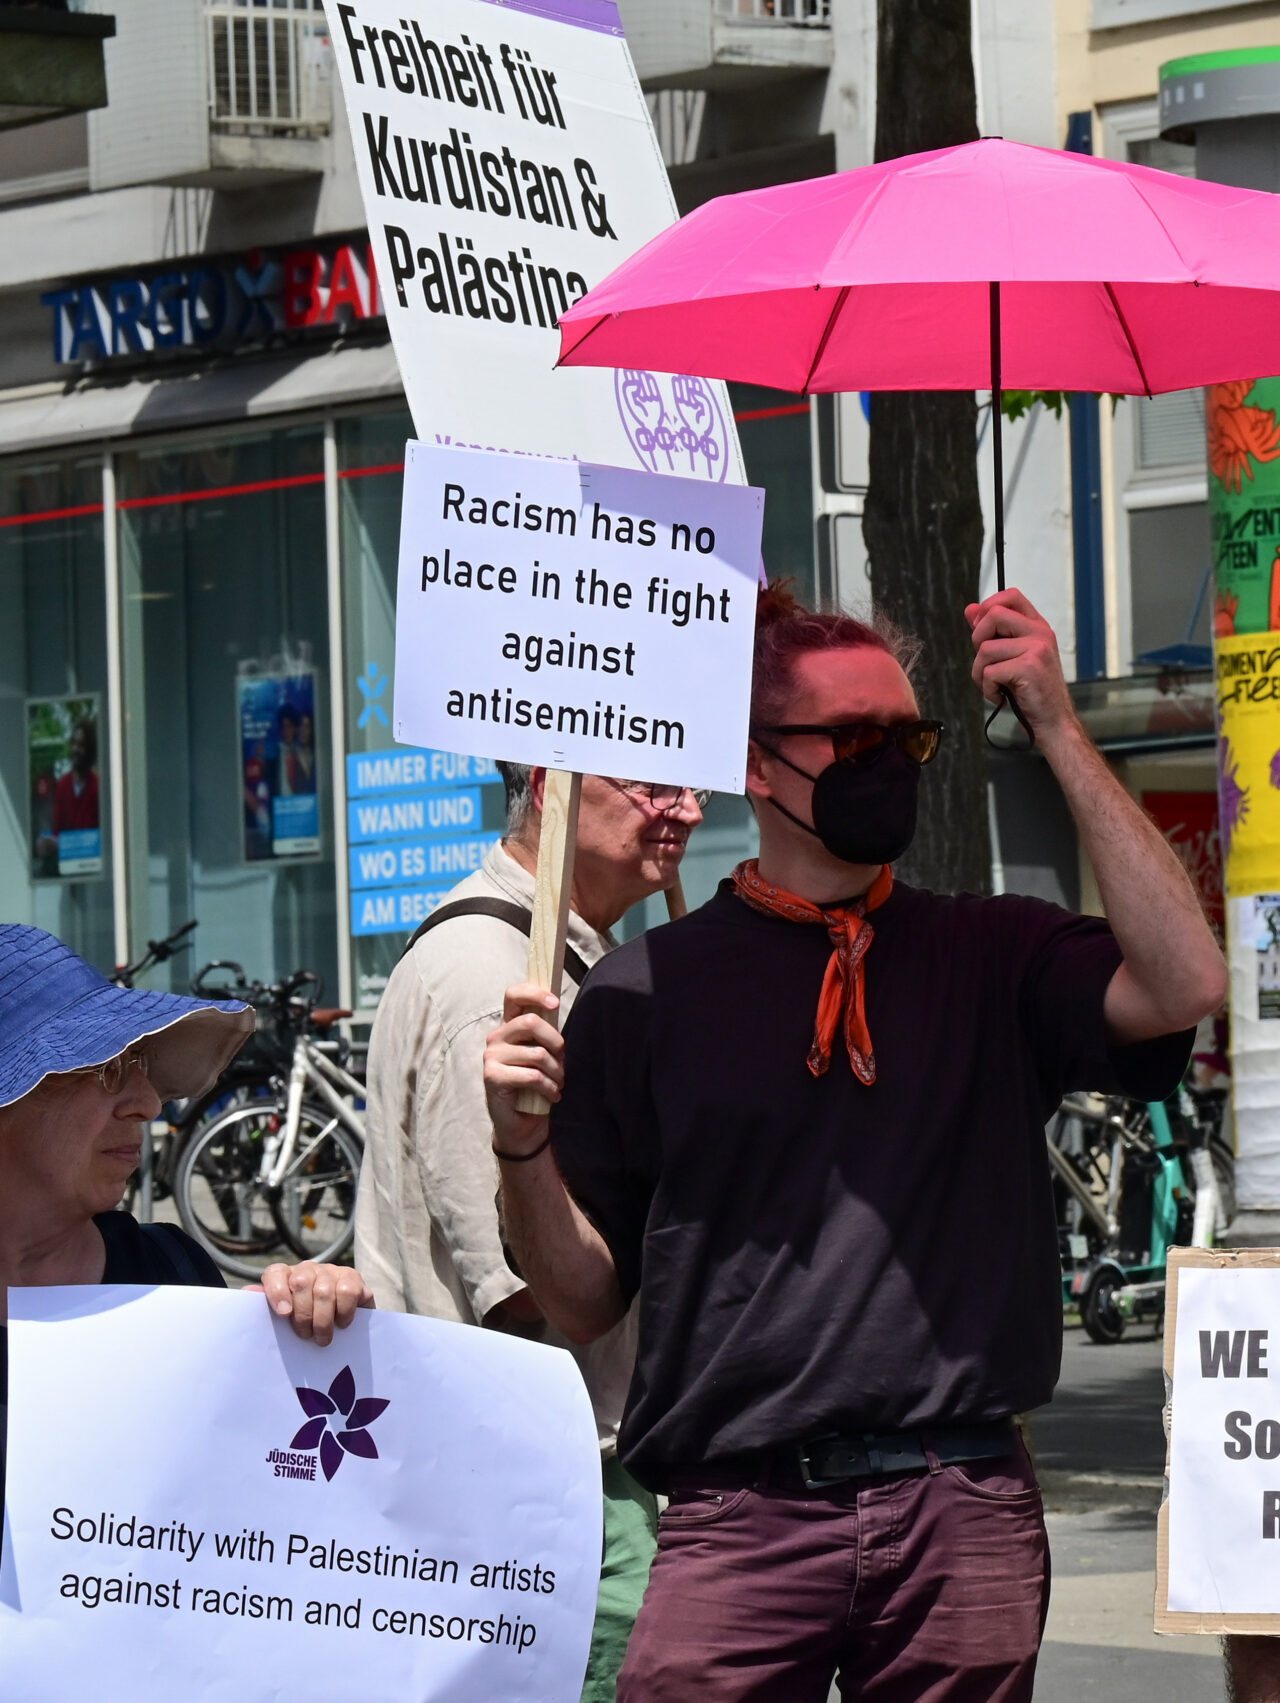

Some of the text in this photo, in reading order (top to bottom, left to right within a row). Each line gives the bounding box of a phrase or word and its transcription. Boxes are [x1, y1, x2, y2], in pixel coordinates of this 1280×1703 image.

[337, 3, 566, 129] Freiheit für
[363, 112, 577, 230] Kurdistan
[581, 158, 618, 240] &
[283, 244, 381, 327] BA
[444, 484, 715, 554] Racism has no
[421, 549, 730, 628] place in the fight
[502, 633, 636, 676] against
[446, 688, 684, 749] antisemitism
[357, 754, 426, 789] IMMER
[358, 797, 474, 834] WANN UND
[359, 852, 397, 880] WO
[402, 847, 425, 876] ES
[361, 897, 395, 927] AM
[1199, 1330, 1268, 1378] WE
[266, 1448, 318, 1469] JÜDISCHE
[274, 1464, 316, 1481] STIMME
[50, 1507, 555, 1594] Solidarity with Palestinian artists
[59, 1573, 536, 1654] against racism and censorship
